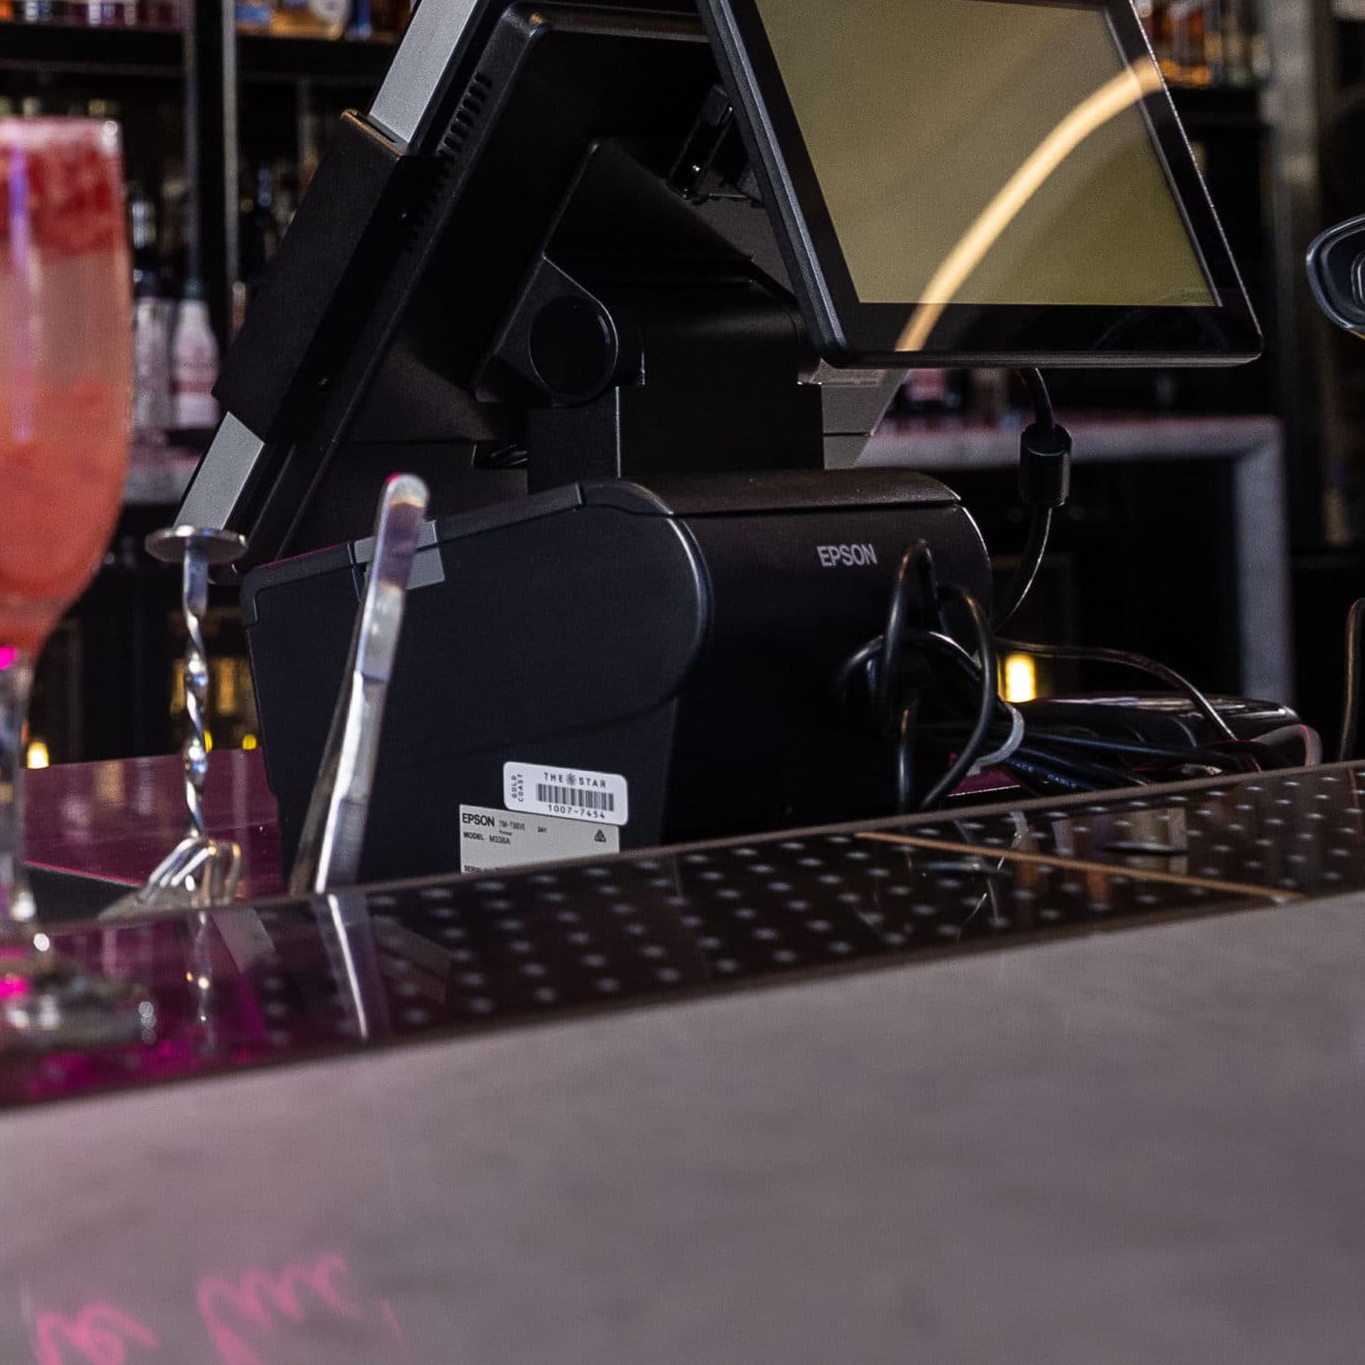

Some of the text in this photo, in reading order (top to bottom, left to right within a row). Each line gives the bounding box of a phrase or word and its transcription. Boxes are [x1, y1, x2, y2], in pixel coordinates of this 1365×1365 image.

[816, 543, 878, 568] EPSON
[543, 771, 607, 789] THE STAR
[462, 813, 495, 828] EPSON
[463, 831, 485, 841] MODEL
